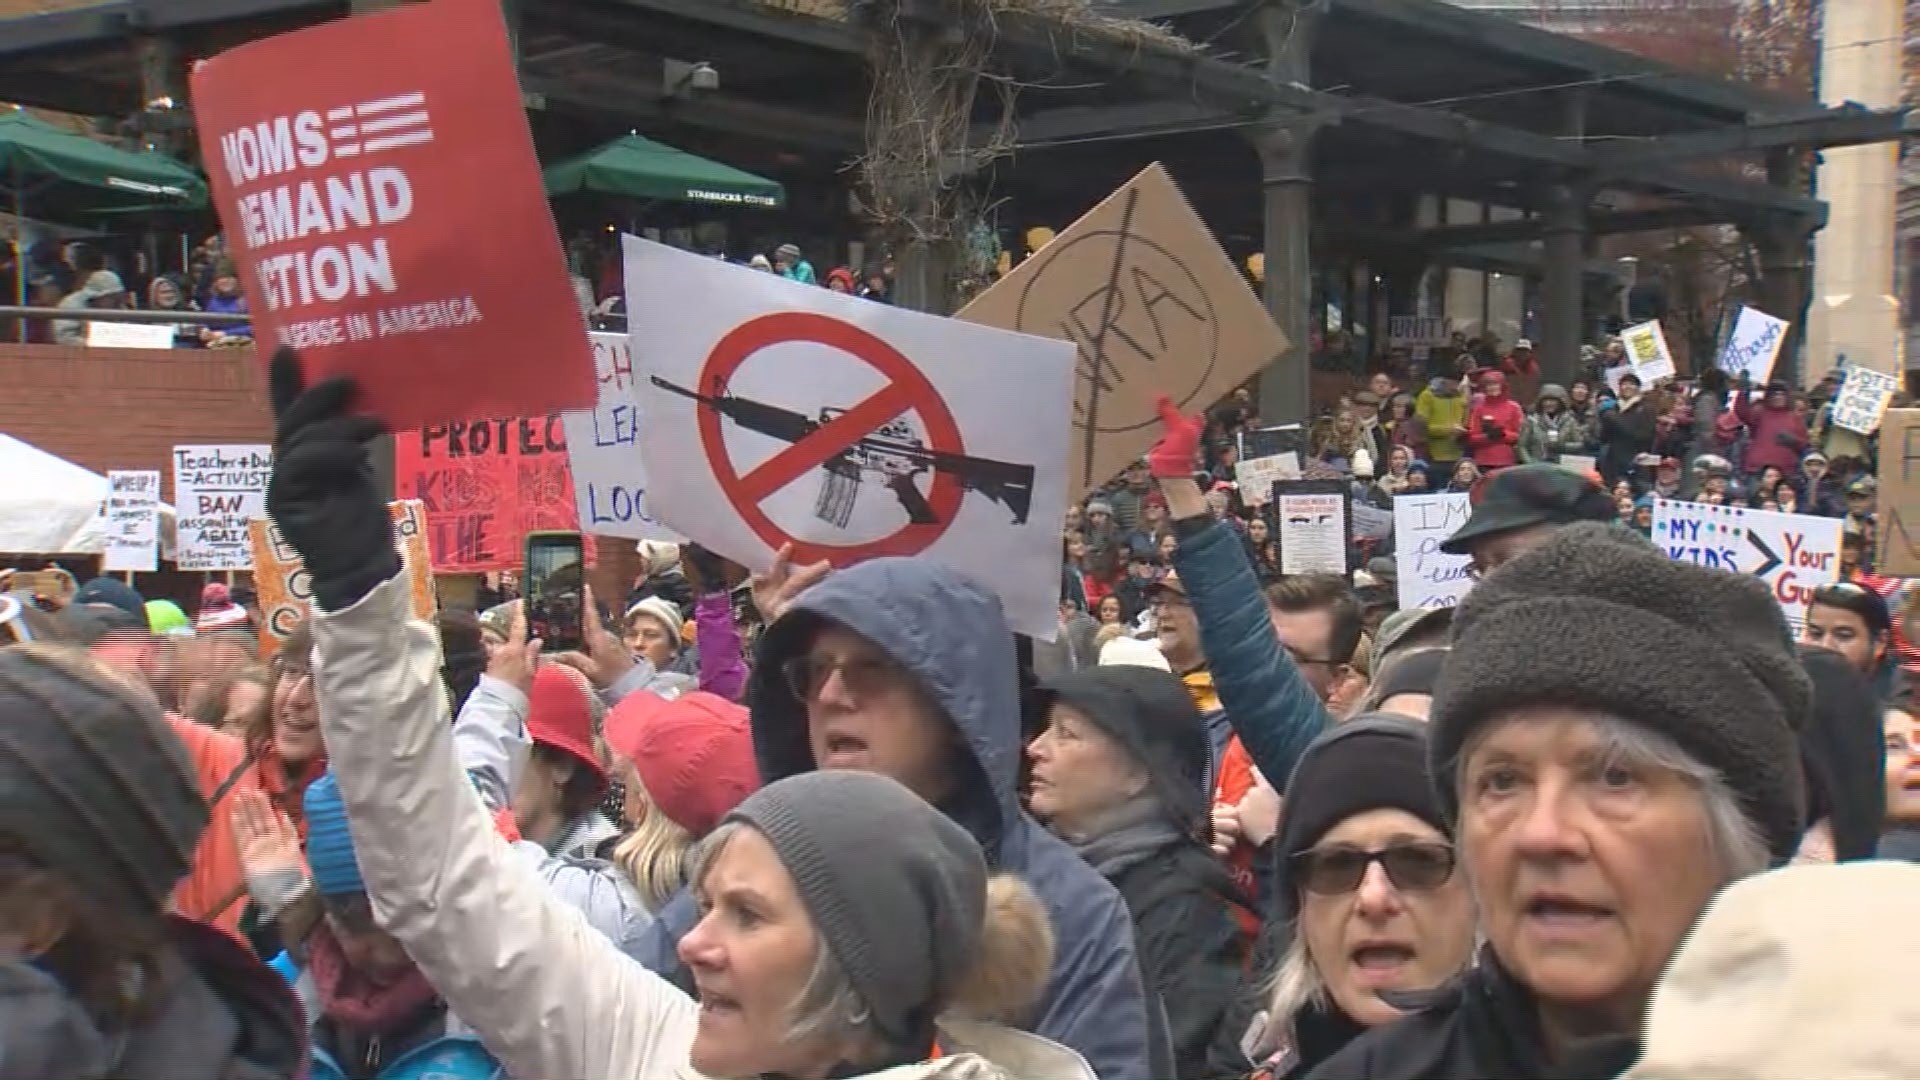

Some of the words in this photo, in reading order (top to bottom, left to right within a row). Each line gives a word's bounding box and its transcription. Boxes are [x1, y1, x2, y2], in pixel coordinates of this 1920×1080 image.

[221, 111, 328, 187] MOMS
[255, 239, 398, 311] CTION
[346, 314, 372, 341] IN
[377, 296, 483, 338] AMERICA
[198, 495, 243, 515] BAN
[1670, 518, 1701, 541] MY
[1784, 532, 1834, 571] Your
